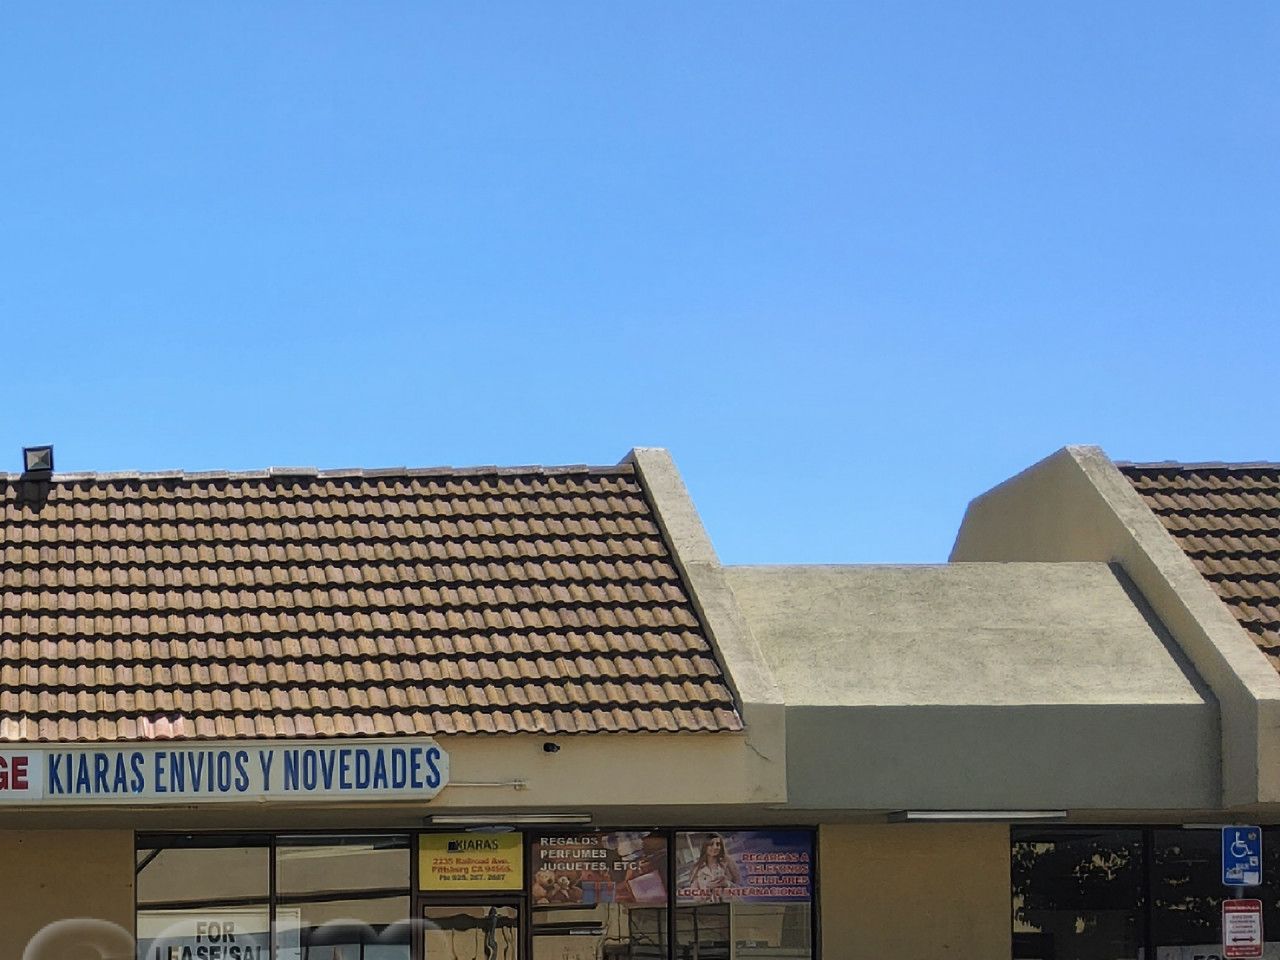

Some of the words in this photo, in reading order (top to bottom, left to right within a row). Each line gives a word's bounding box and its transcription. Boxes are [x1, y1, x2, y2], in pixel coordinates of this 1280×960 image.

[48, 752, 145, 795] KIARAS
[154, 750, 249, 792] ENVIOS
[258, 749, 275, 791] Y
[284, 747, 440, 791] NOVEDADES
[540, 837, 598, 846] REGALOS
[540, 849, 607, 859] PERFUMES
[196, 921, 236, 943] FOR
